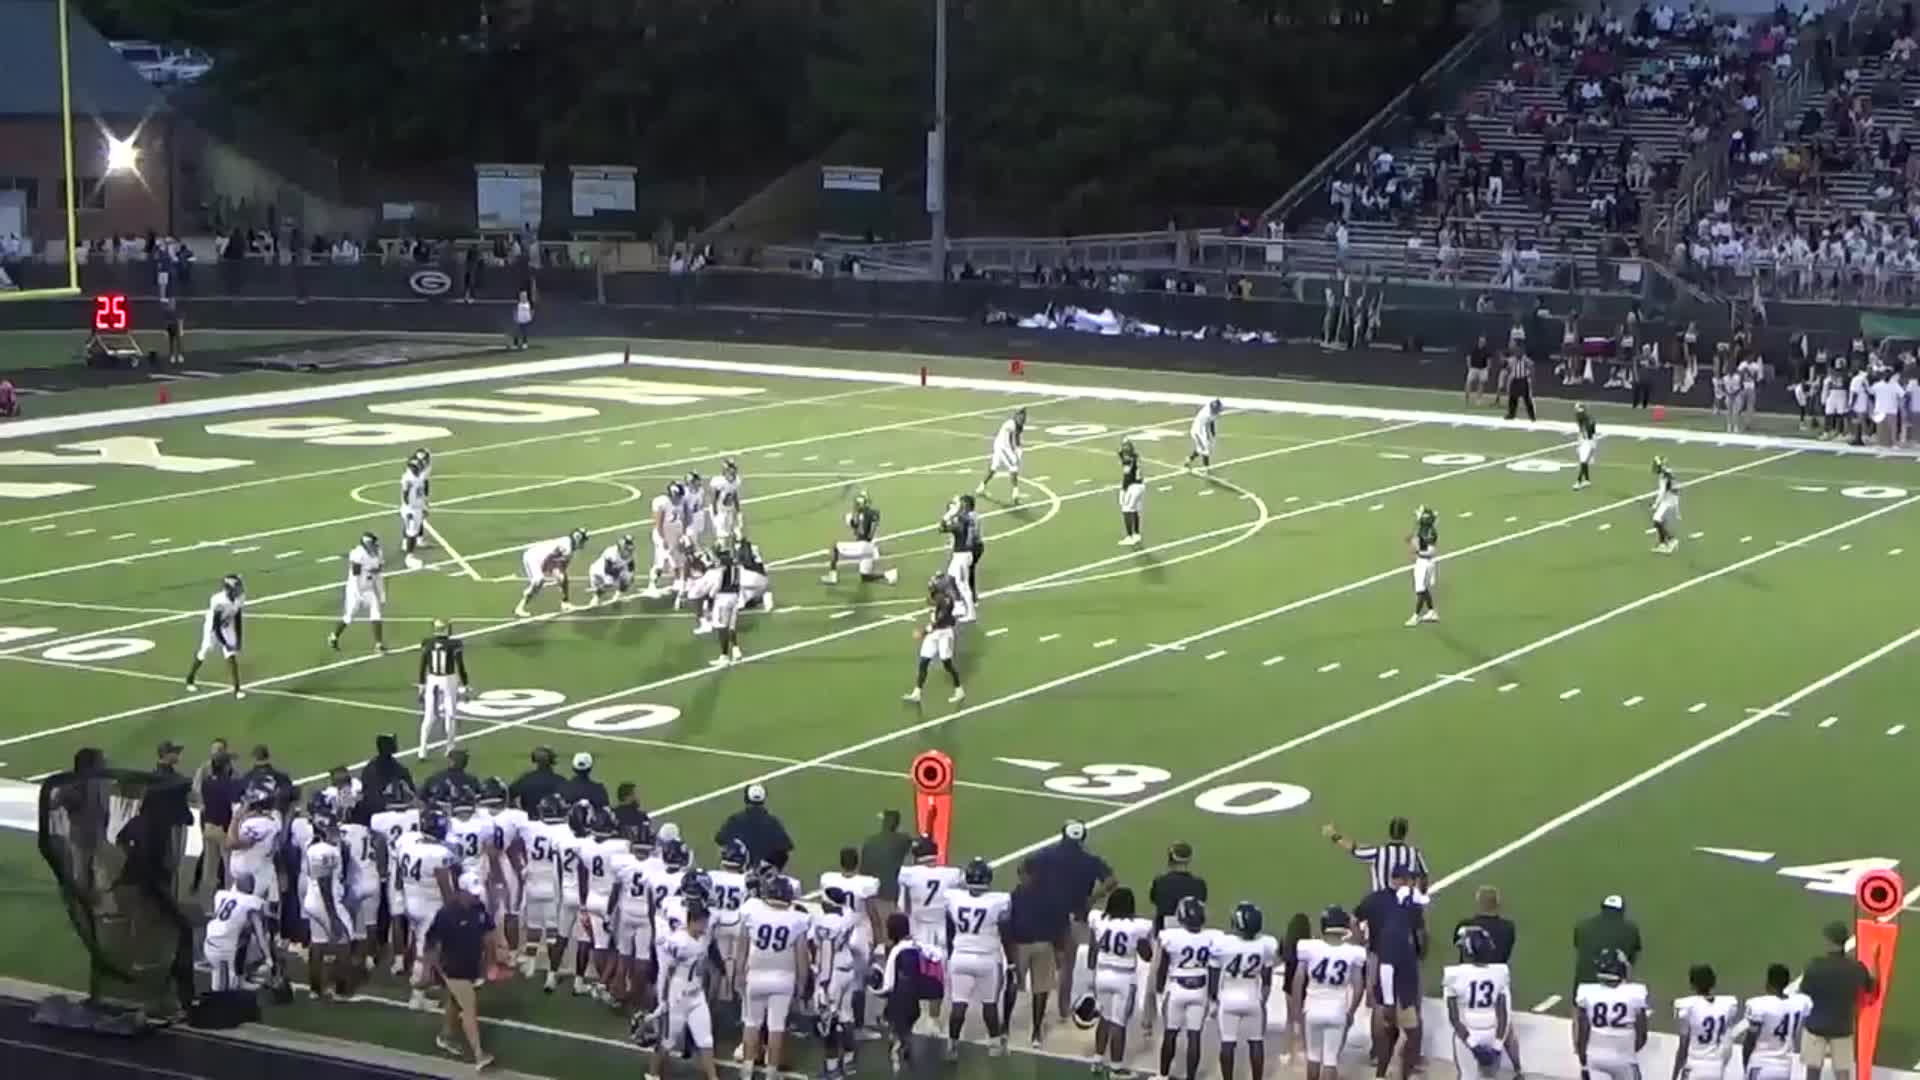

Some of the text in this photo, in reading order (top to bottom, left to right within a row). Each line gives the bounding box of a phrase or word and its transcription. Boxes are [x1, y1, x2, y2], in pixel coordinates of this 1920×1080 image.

[96, 296, 126, 328] 25
[431, 650, 447, 673] 11
[1043, 763, 1312, 815] 30
[401, 853, 422, 881] 64
[924, 879, 940, 906] 7
[216, 898, 238, 921] 18
[958, 906, 987, 934] 57
[756, 924, 790, 951] 99
[1100, 929, 1129, 956] 46
[1178, 946, 1210, 968] 29
[1225, 953, 1261, 979] 42
[1311, 957, 1348, 985] 43
[1468, 980, 1495, 1009] 13
[1592, 1002, 1628, 1028] 82
[1774, 1011, 1800, 1041] 41
[1698, 1014, 1726, 1044] 31
